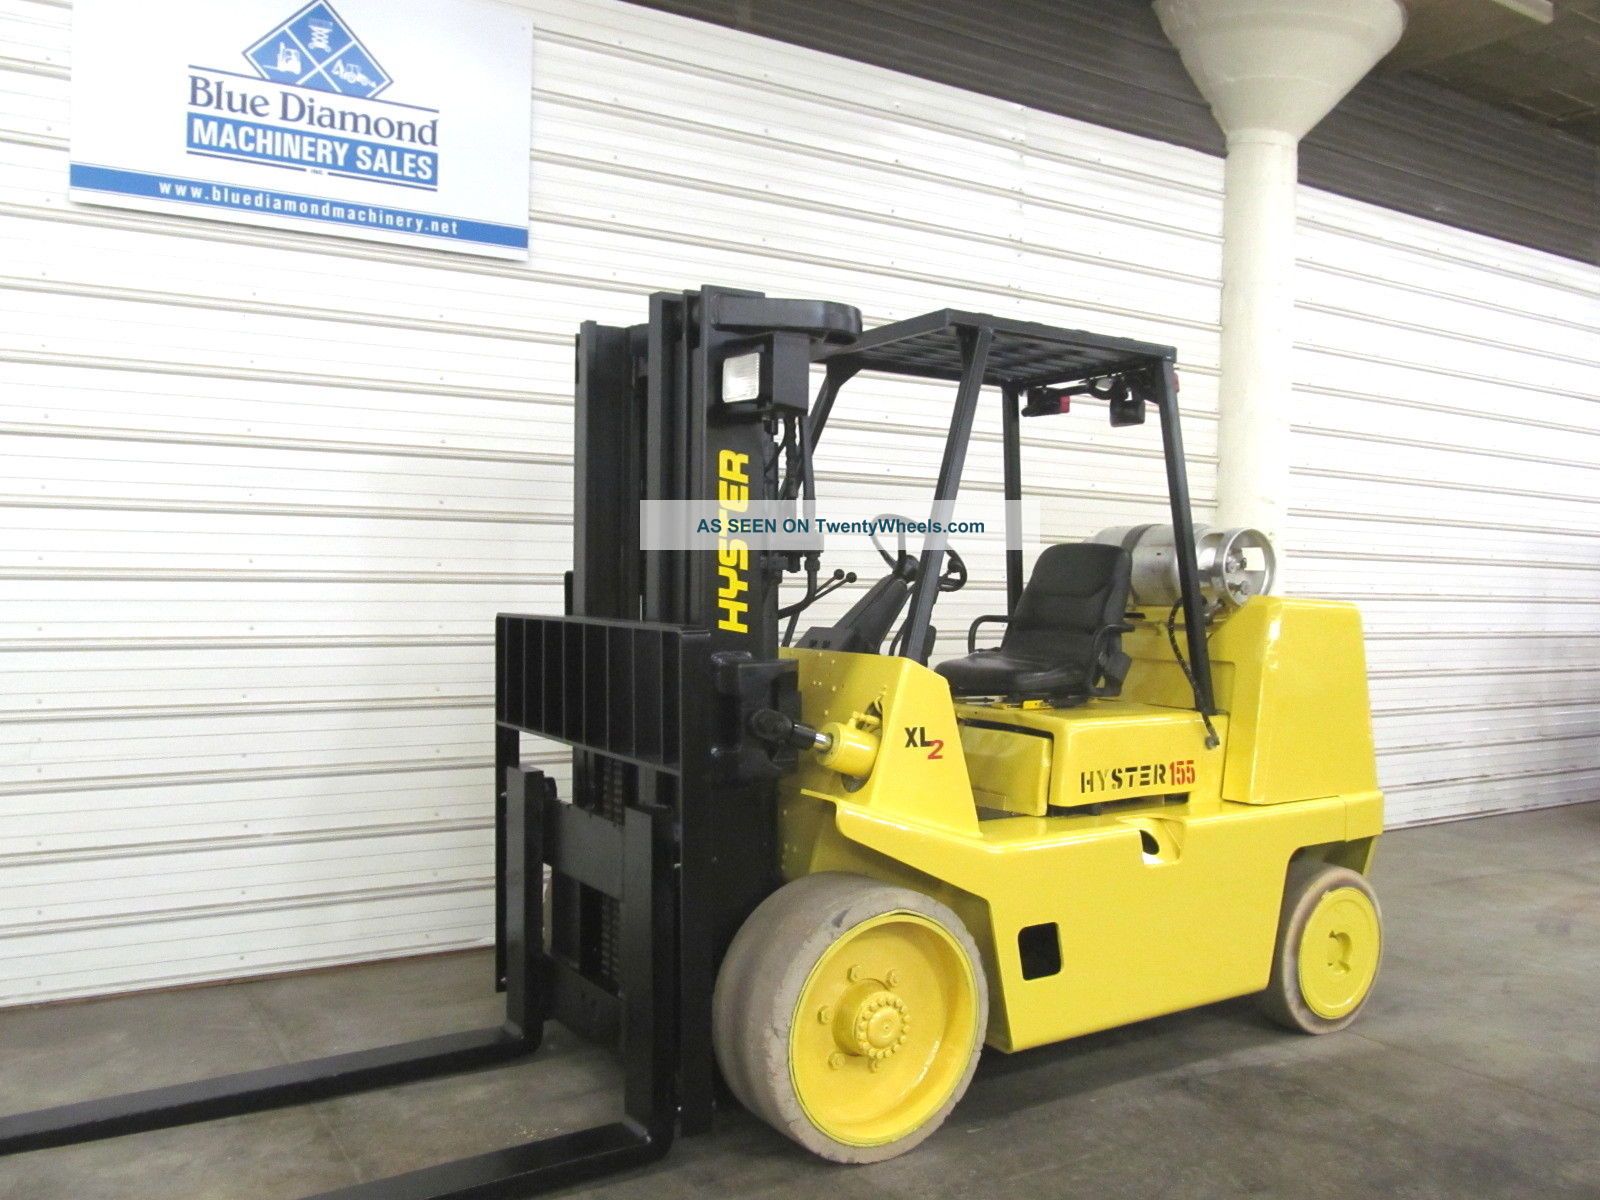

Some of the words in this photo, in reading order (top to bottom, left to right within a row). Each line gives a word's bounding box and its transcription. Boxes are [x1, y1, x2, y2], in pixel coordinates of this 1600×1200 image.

[188, 75, 270, 118] Blue
[279, 91, 439, 147] Diamond
[192, 118, 349, 167] MACHINERY
[355, 144, 432, 181] SALES
[158, 180, 459, 236] www.bluediamondmachinery.net
[718, 449, 750, 634] HYSTER
[1081, 764, 1166, 793] HYSTER
[1169, 760, 1196, 786] 155
